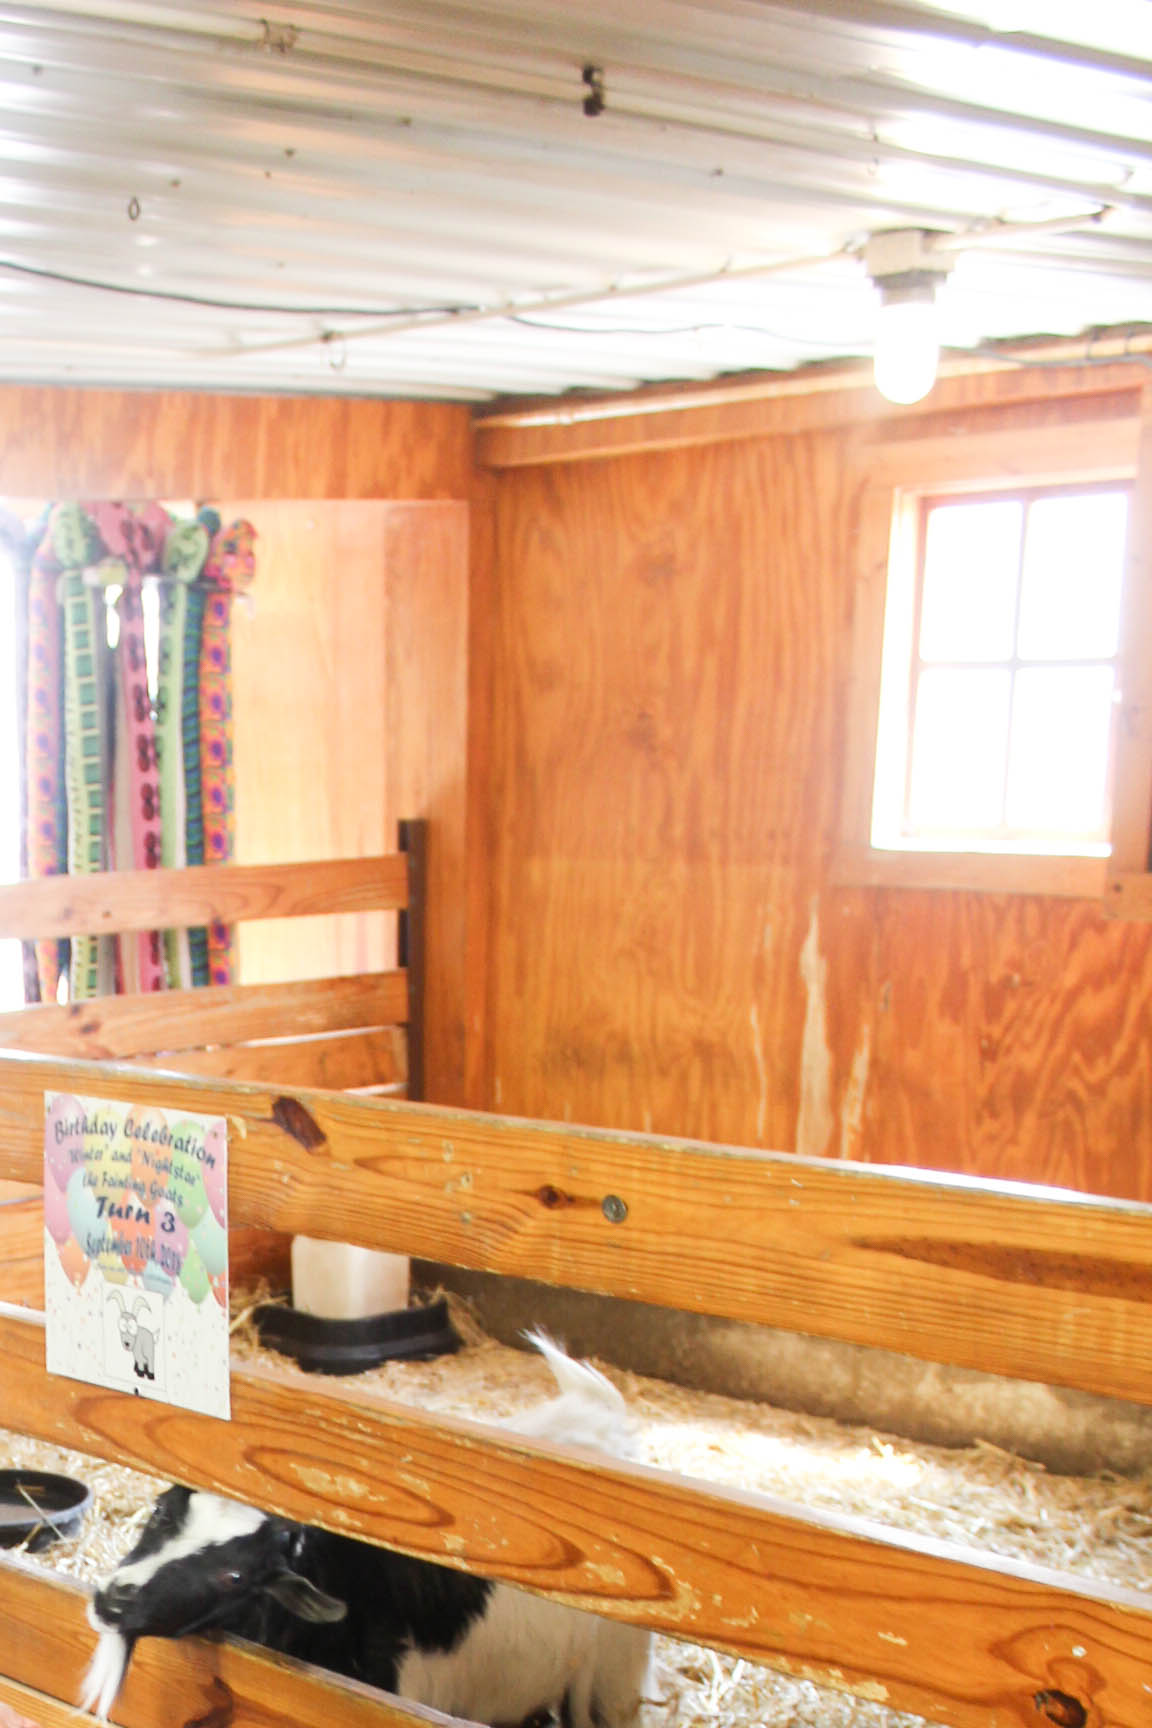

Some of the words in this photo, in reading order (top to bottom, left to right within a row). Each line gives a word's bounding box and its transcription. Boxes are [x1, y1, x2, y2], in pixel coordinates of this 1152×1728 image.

[54, 1114, 118, 1145] Birthday
[123, 1118, 217, 1170] Celebration
[111, 1147, 133, 1163] and
[102, 1171, 147, 1199] Fainting
[149, 1181, 184, 1208] Goats
[96, 1195, 151, 1225] Turn
[160, 1210, 176, 1233] 3
[84, 1231, 133, 1261] September
